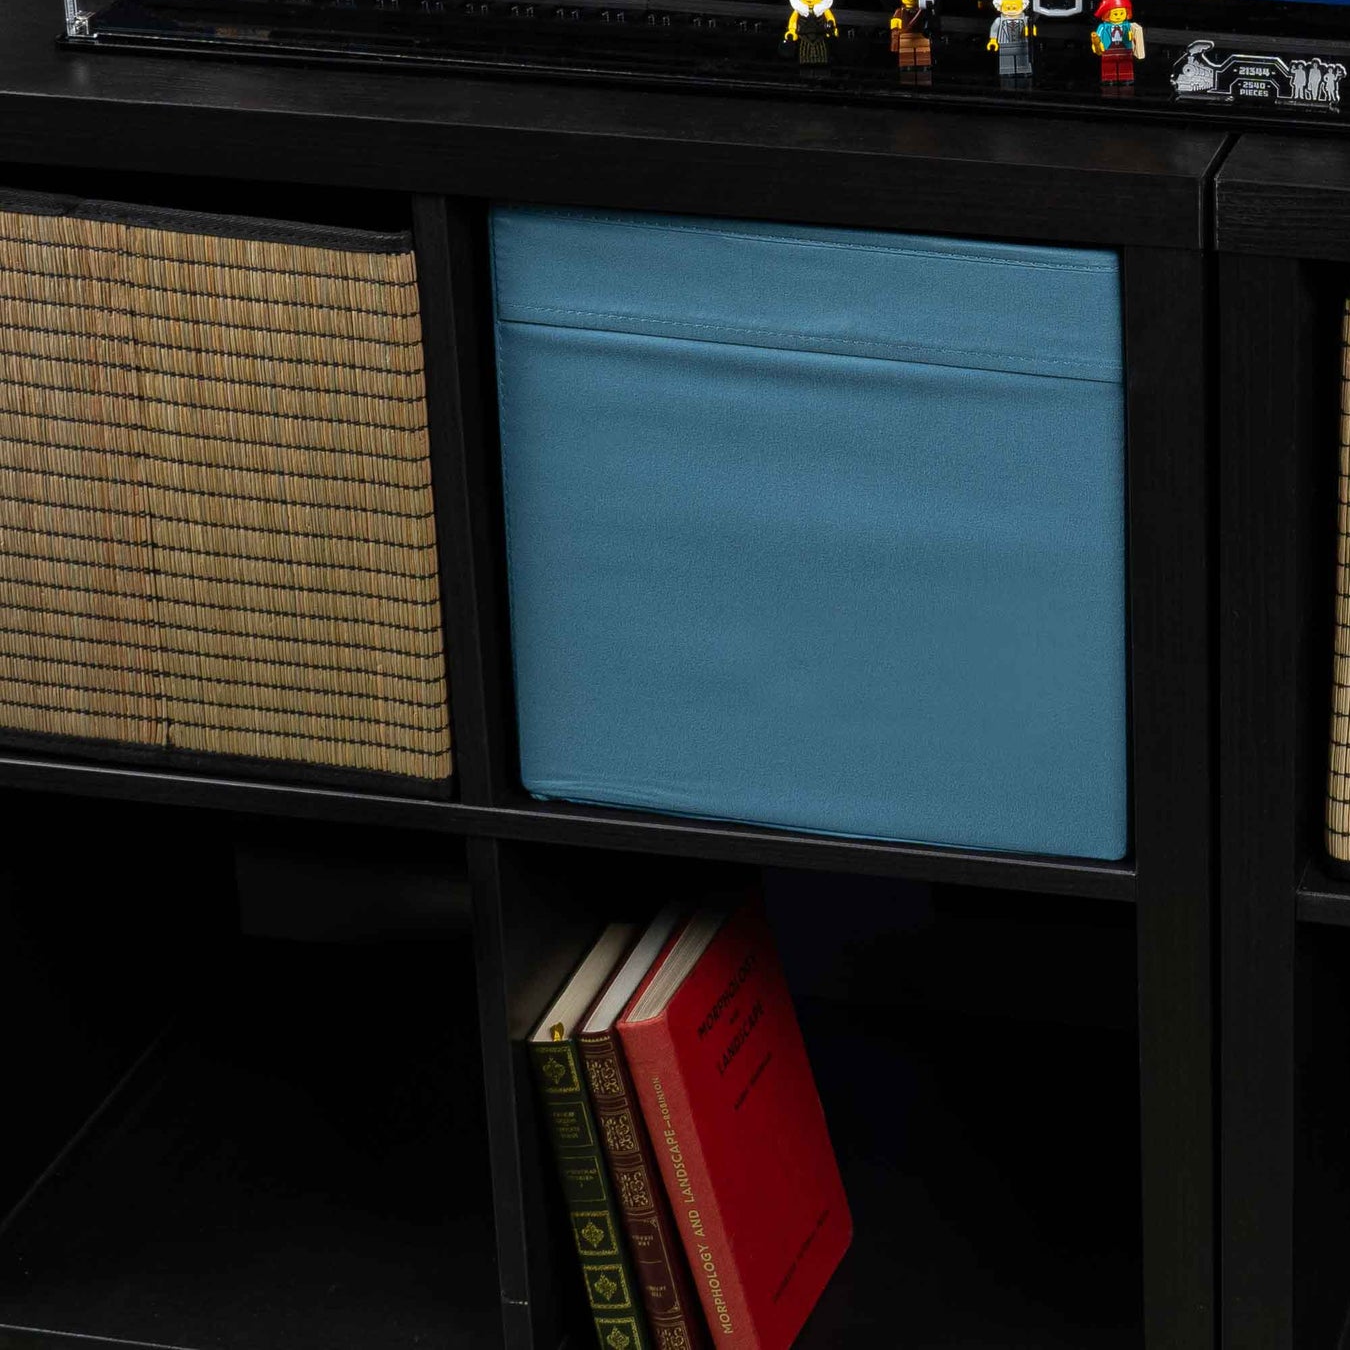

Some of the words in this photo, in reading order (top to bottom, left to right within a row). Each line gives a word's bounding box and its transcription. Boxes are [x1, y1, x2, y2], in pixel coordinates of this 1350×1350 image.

[1239, 89, 1269, 97] PIECES
[1242, 81, 1266, 90] 2540
[688, 1208, 706, 1238] AND
[698, 1243, 734, 1335] MORPHOLOGY
